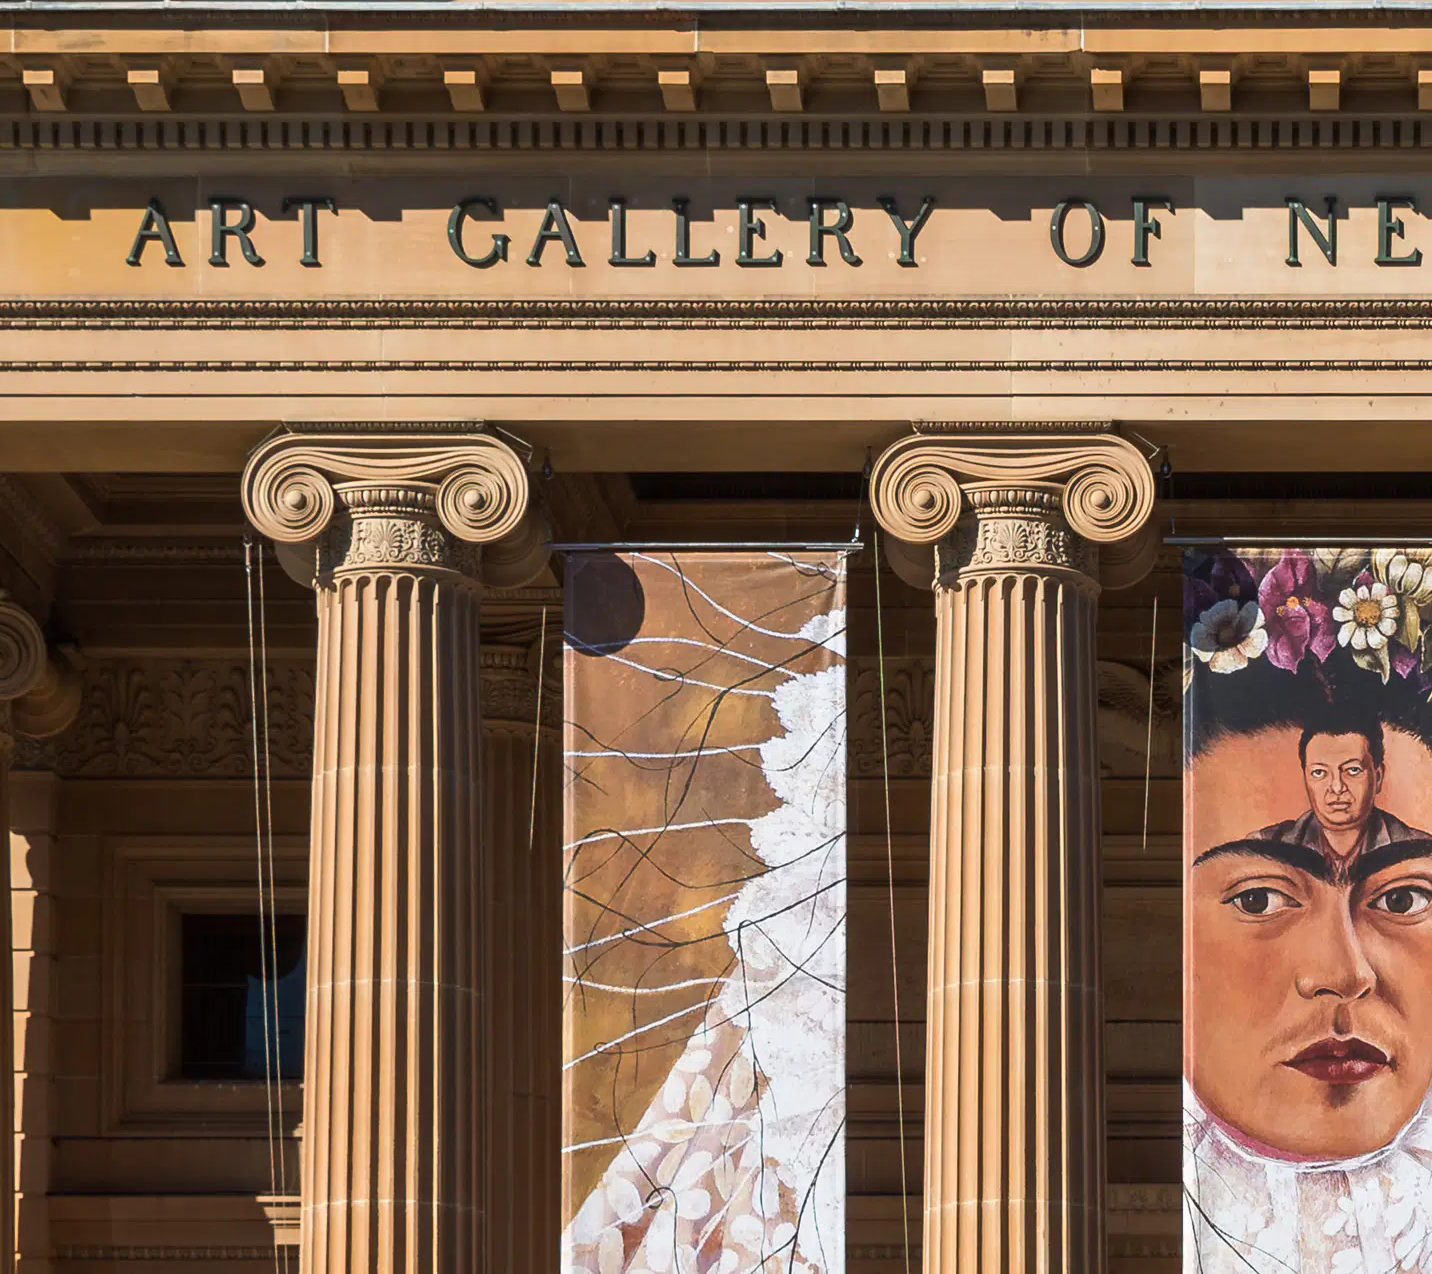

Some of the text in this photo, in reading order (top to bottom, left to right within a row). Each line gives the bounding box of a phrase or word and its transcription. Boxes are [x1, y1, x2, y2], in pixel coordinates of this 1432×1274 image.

[125, 197, 339, 267] ART
[447, 196, 934, 268] GALLERY
[1049, 198, 1176, 268] OF
